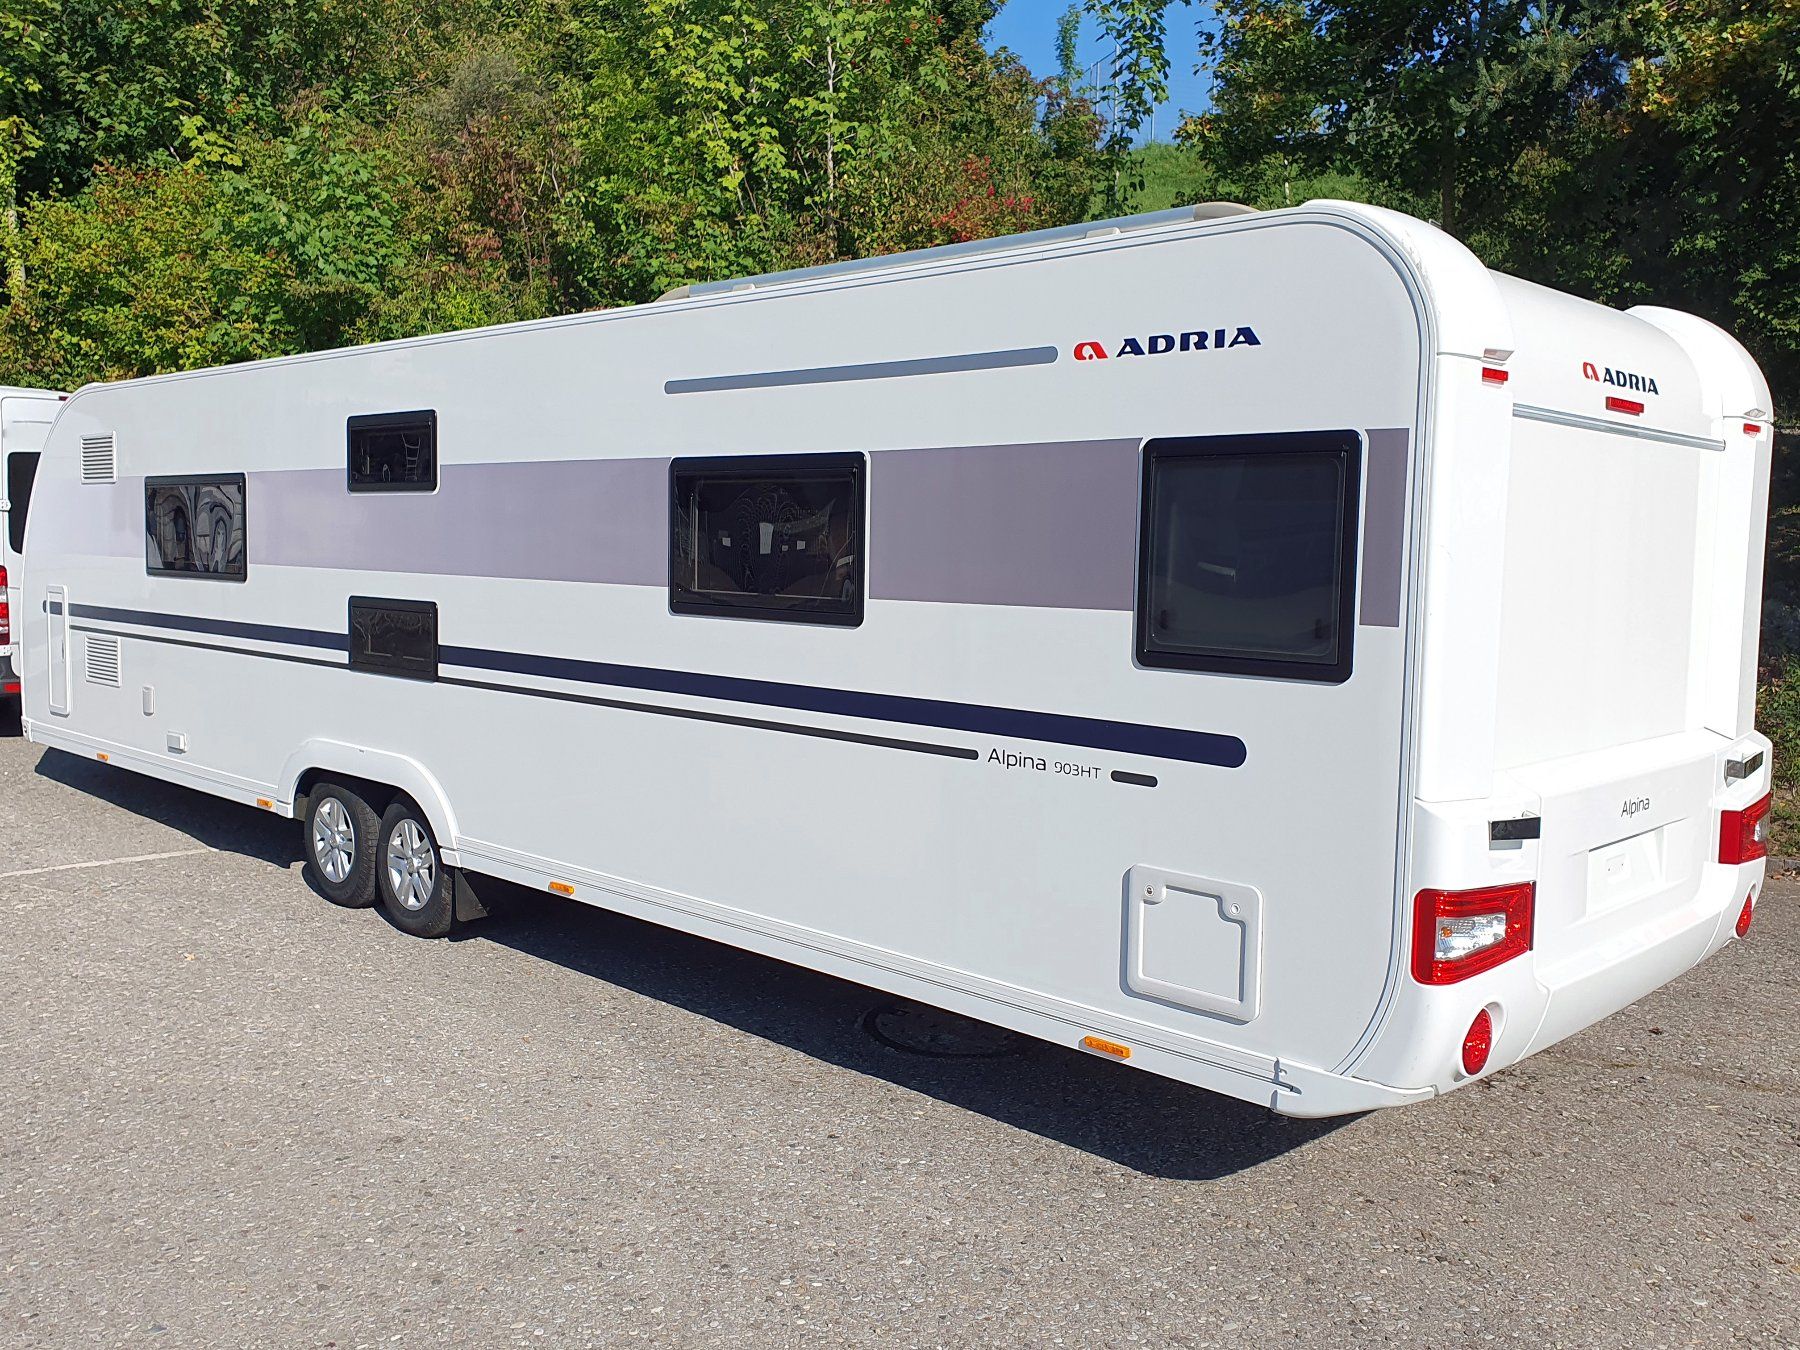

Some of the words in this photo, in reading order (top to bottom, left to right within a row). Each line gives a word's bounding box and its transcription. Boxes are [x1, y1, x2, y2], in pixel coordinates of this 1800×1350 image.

[1116, 327, 1261, 358] ADRIA
[1603, 367, 1659, 395] ADRIA
[987, 747, 1047, 772] Alpina
[1054, 761, 1102, 780] 903HT
[1620, 797, 1650, 818] Alpina
